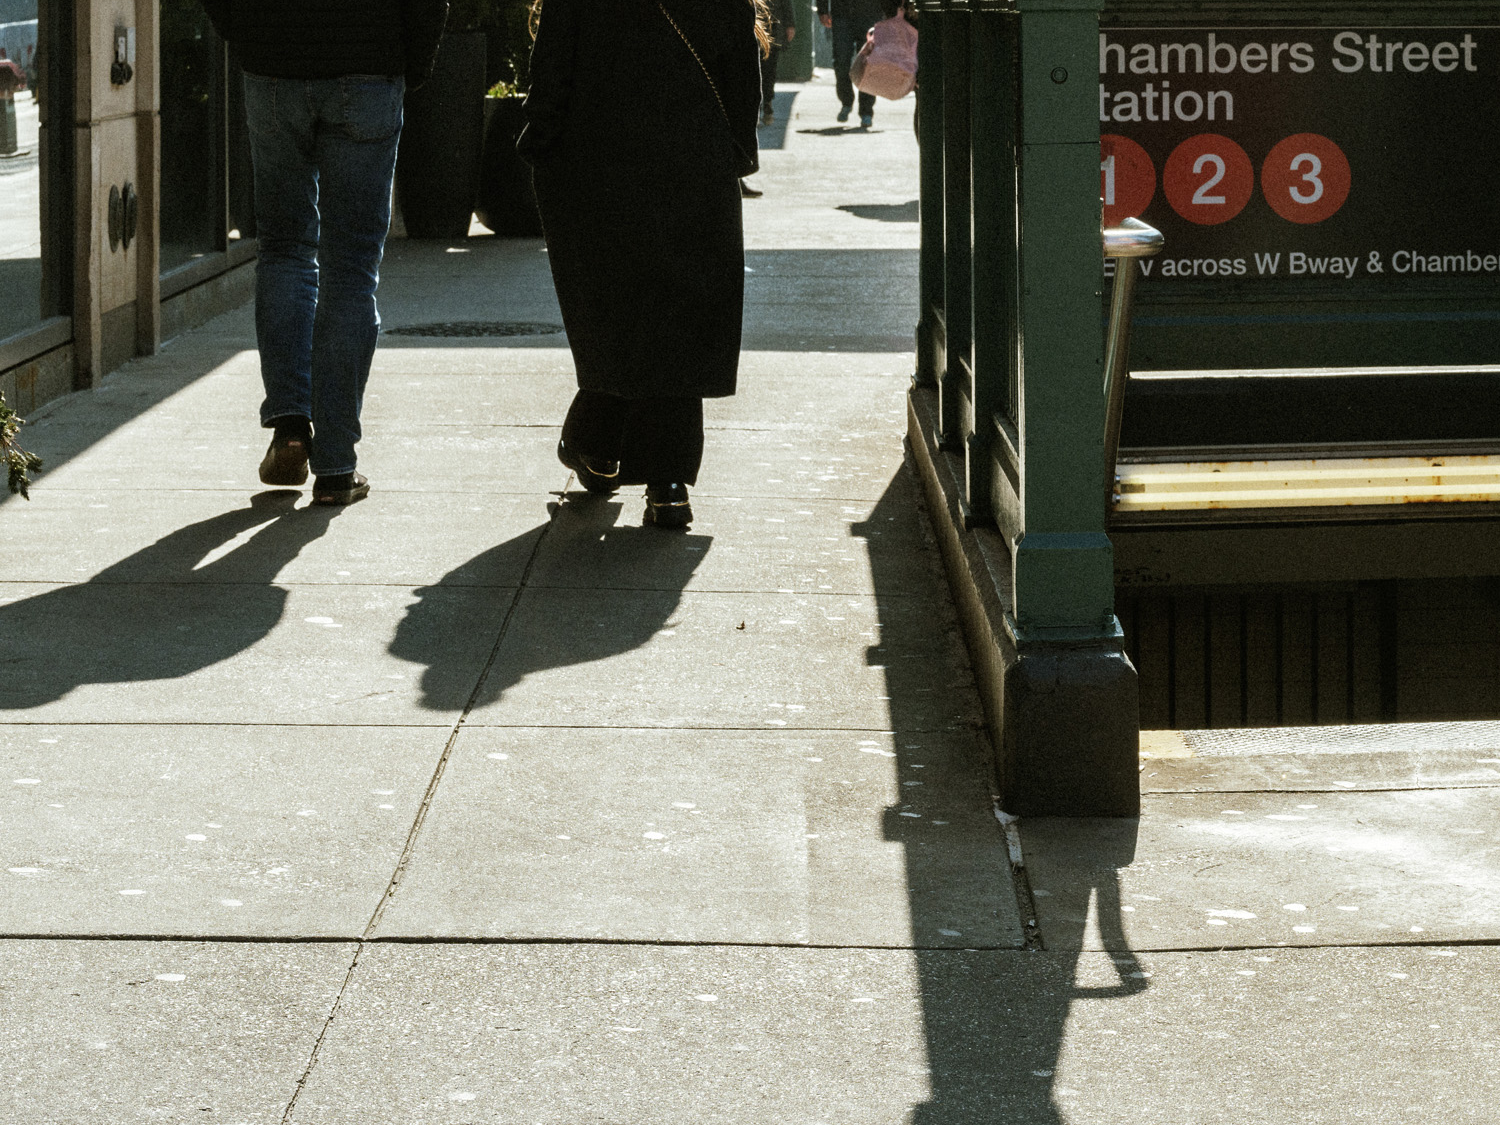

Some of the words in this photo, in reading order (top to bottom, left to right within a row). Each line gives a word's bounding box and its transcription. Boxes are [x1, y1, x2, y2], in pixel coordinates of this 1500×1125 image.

[1099, 32, 1315, 74] hambers
[1332, 31, 1478, 73] Street
[1099, 80, 1234, 122] tation
[1100, 154, 1116, 205] 1
[1191, 153, 1226, 205] 2
[1289, 152, 1325, 205] 3
[1161, 257, 1247, 276] across
[1254, 252, 1281, 274] W
[1289, 251, 1358, 278] Bway
[1366, 251, 1384, 273] &
